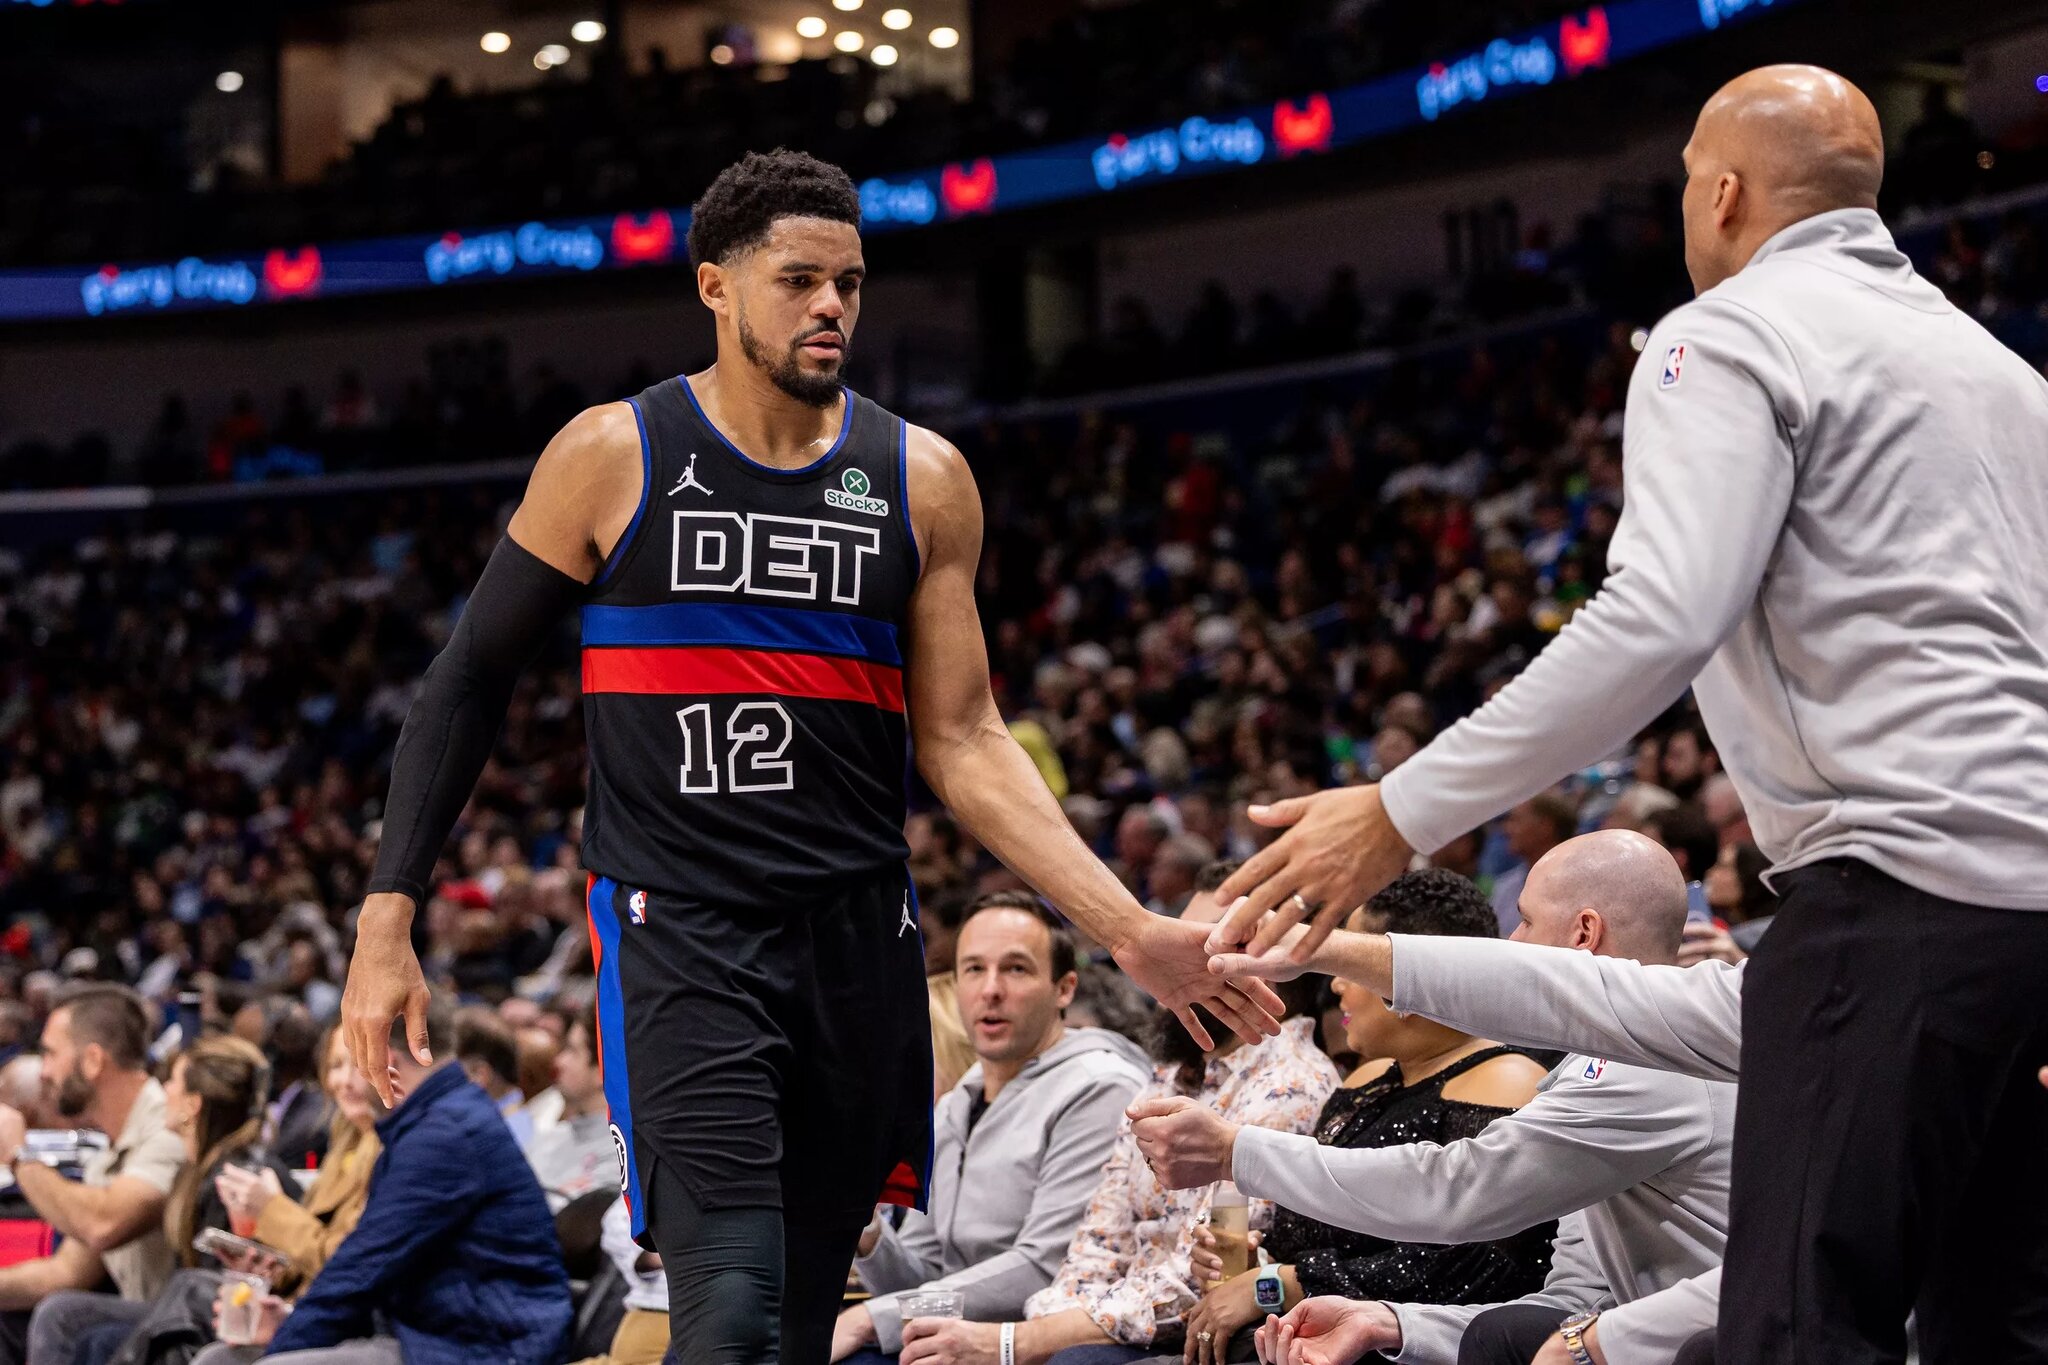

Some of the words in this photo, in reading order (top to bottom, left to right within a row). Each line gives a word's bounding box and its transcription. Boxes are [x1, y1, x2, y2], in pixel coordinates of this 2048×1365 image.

[827, 491, 886, 514] StockX
[671, 511, 880, 606] DET
[677, 702, 793, 793] 12
